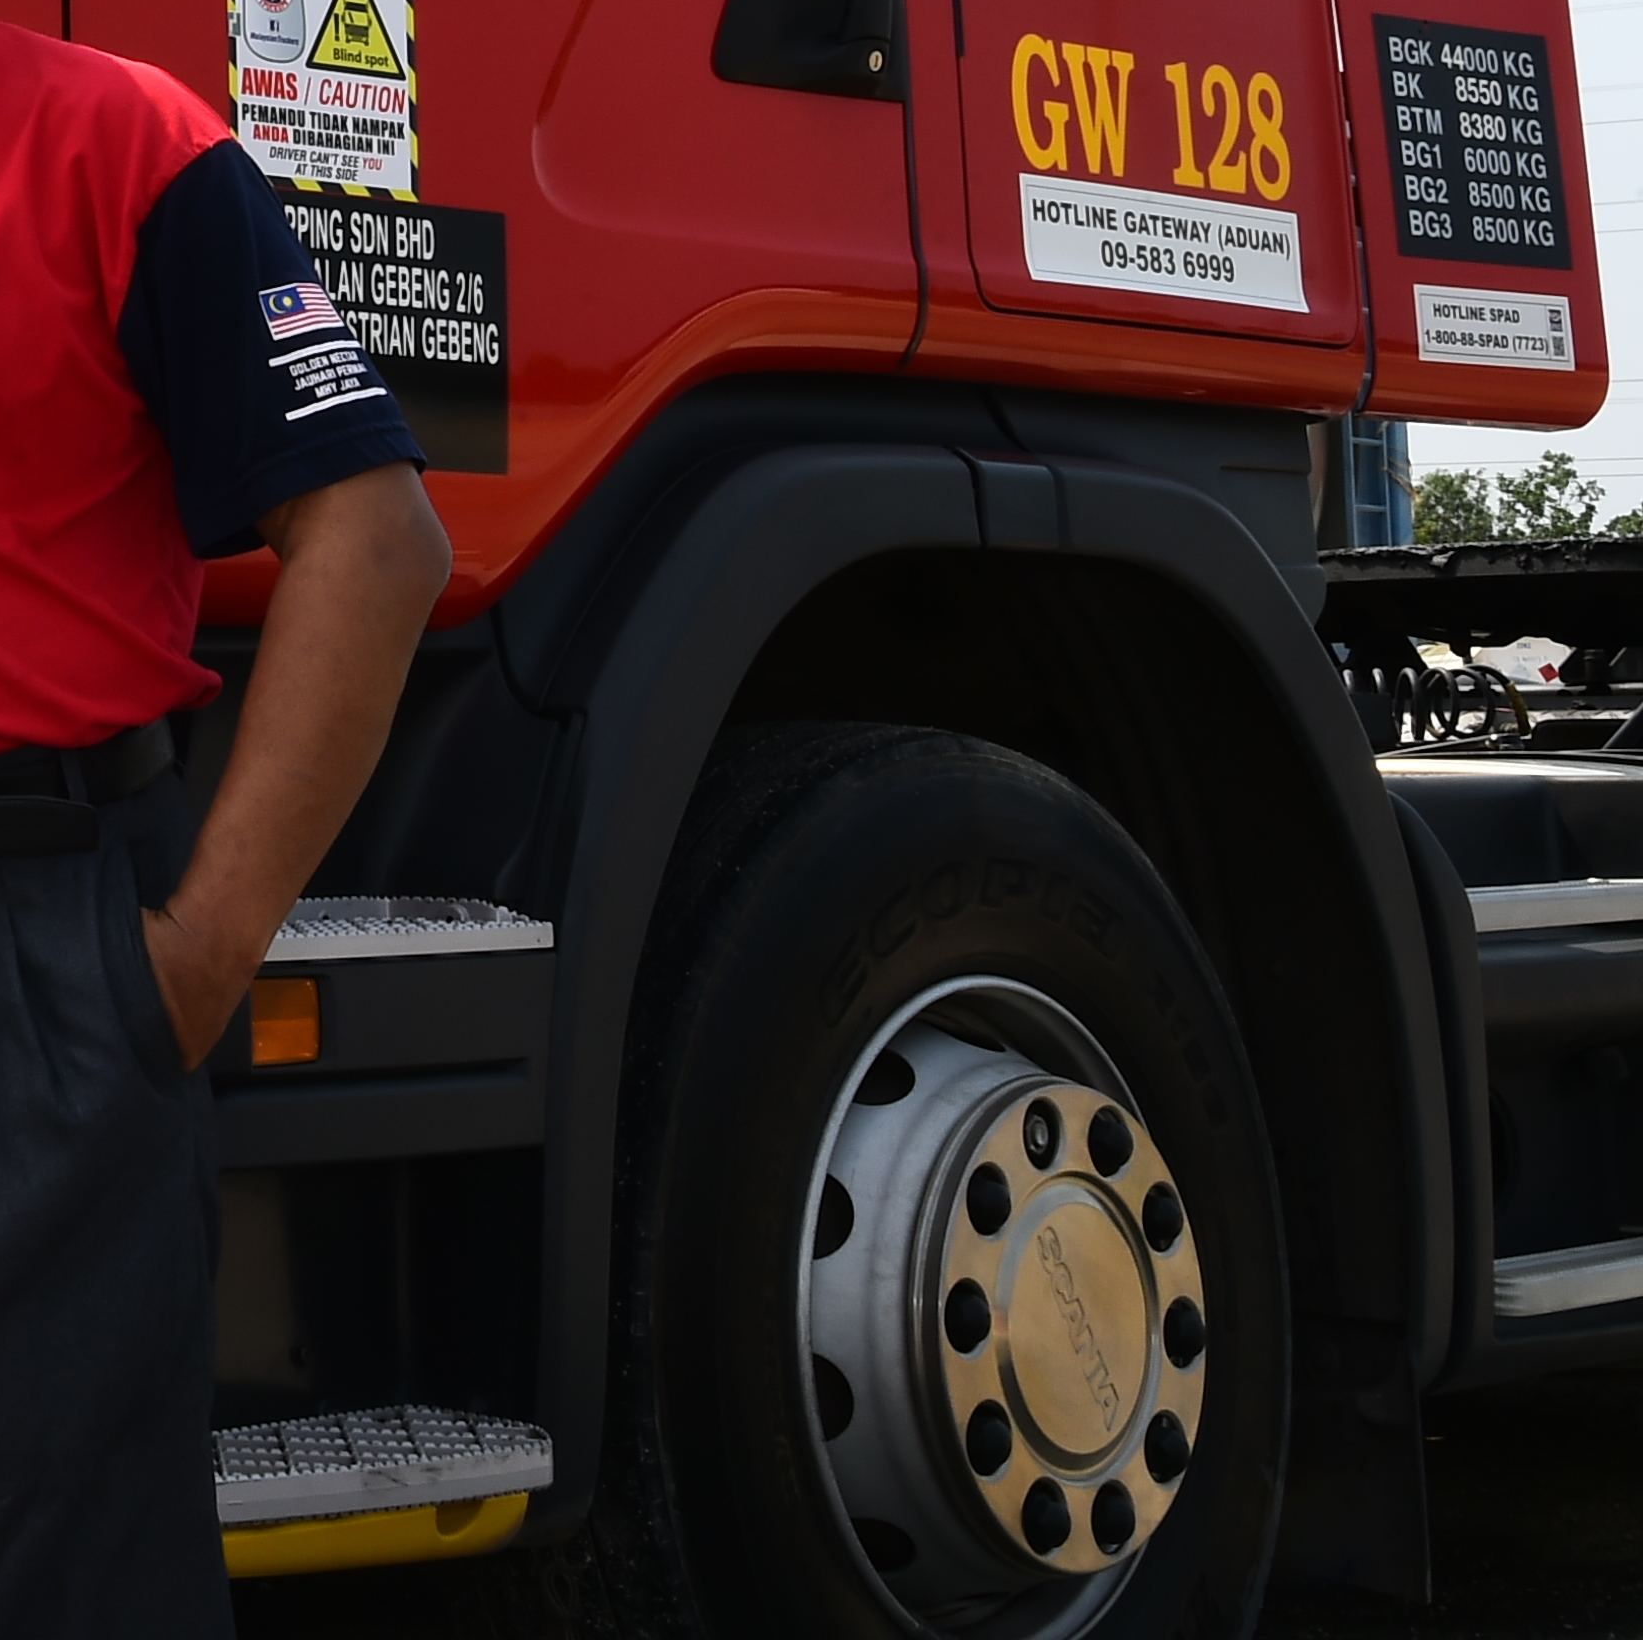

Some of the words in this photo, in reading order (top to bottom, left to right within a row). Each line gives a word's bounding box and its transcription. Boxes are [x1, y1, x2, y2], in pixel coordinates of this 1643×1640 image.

[333, 48, 362, 64] Blind
[365, 54, 389, 69] spot
[1388, 36, 1434, 67] BGK
[1440, 43, 1499, 74] 44000
[1502, 50, 1535, 78] KG
[241, 67, 298, 101] AWAS
[319, 78, 406, 114] CAUTION
[1392, 71, 1424, 99] BK
[1455, 76, 1502, 106] 8550
[1507, 84, 1539, 112] KG
[242, 103, 306, 128] PEMANDU
[309, 111, 349, 134] TIDAK
[352, 116, 405, 140] NAMPAK
[1011, 33, 1134, 177] GW
[1165, 61, 1291, 202] 128
[1396, 105, 1443, 135] BTM
[1459, 112, 1507, 142] 8380
[1511, 118, 1543, 145] KG
[253, 124, 289, 144] ANDA
[293, 128, 373, 154] DIBAHAGIAN
[377, 139, 395, 156] INI
[269, 146, 307, 161] DRIVER
[309, 150, 339, 165] CAN'T
[341, 155, 359, 169] SEE
[362, 158, 382, 171] YOU
[1401, 140, 1443, 169] BG1
[1463, 147, 1511, 176] 6000
[1515, 152, 1548, 179] KG
[295, 163, 307, 176] AT
[311, 165, 333, 179] THIS
[335, 168, 358, 181] SIDE
[1404, 174, 1449, 204] BG2
[1468, 181, 1515, 210] 8500
[1519, 185, 1551, 213] KG
[284, 204, 344, 252] PPING
[350, 211, 389, 256] SDN
[396, 216, 435, 260] BHD
[1032, 198, 1118, 231] HOTLINE
[1123, 211, 1211, 243] GATEWAY
[1217, 223, 1291, 261] (ADUAN)
[1409, 209, 1453, 239] BG3
[1472, 216, 1519, 244] 8500
[1523, 219, 1555, 247] KG
[1101, 240, 1176, 275] 09-583
[1183, 250, 1235, 283] 6999
[371, 263, 450, 311] GEBENG
[456, 272, 483, 314] 2/6
[1433, 303, 1486, 321] HOTLINE
[1489, 308, 1520, 323] SPAD
[342, 309, 415, 357] STRIAN
[422, 317, 499, 364] GEBENG
[1424, 329, 1509, 349] 1-800-88-SPAD
[1512, 335, 1550, 356] (7723)
[288, 356, 329, 377] GOLDEN
[339, 377, 361, 391] JAYA
[1037, 1225, 1120, 1432] SCANIA
